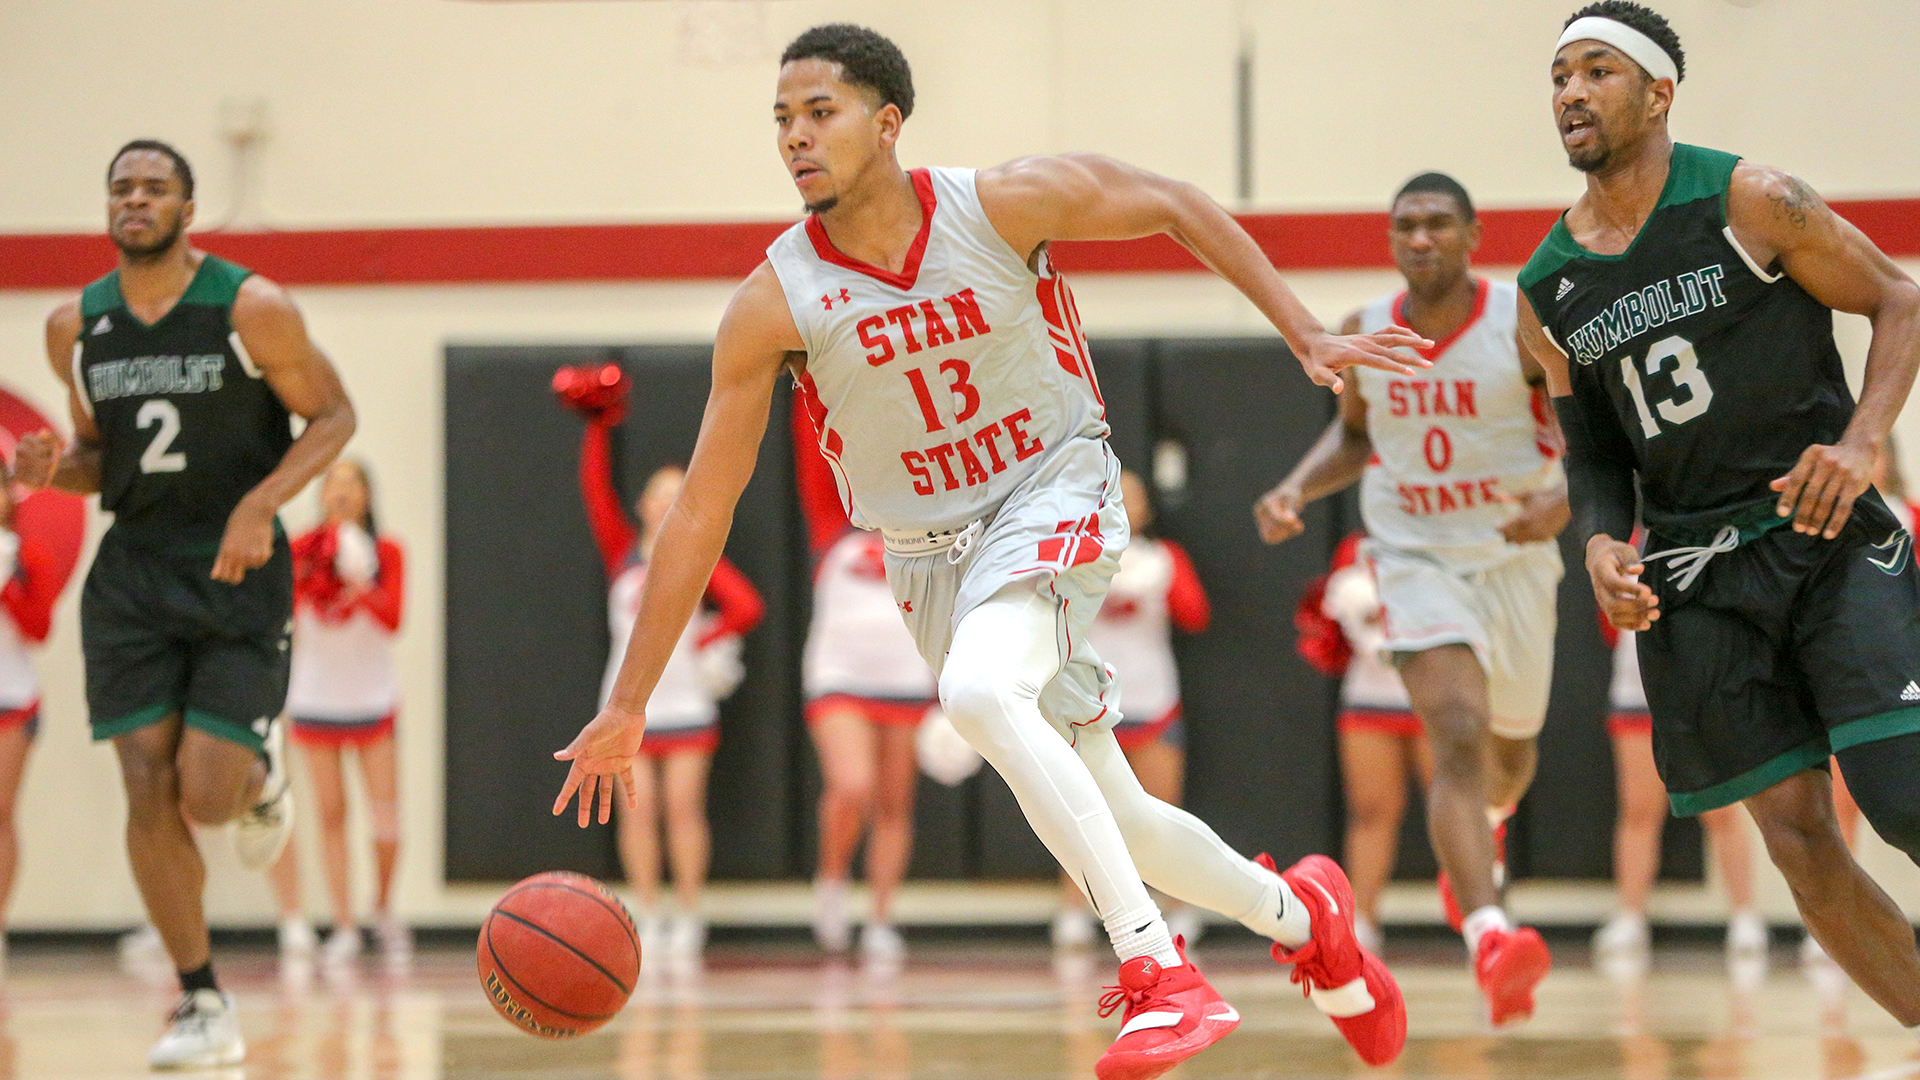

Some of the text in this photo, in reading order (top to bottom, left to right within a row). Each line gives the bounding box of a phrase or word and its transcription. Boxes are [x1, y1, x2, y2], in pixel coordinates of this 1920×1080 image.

[856, 287, 991, 367] STAN
[1567, 264, 1727, 366] HUMBOLDT
[88, 354, 225, 402] HUMBOLDT
[903, 358, 980, 433] 13
[1388, 379, 1478, 418] STAN
[1620, 335, 1714, 439] 13
[136, 399, 187, 474] 2
[901, 407, 1044, 496] STATE
[1424, 426, 1452, 474] 0
[1397, 476, 1499, 516] STATE
